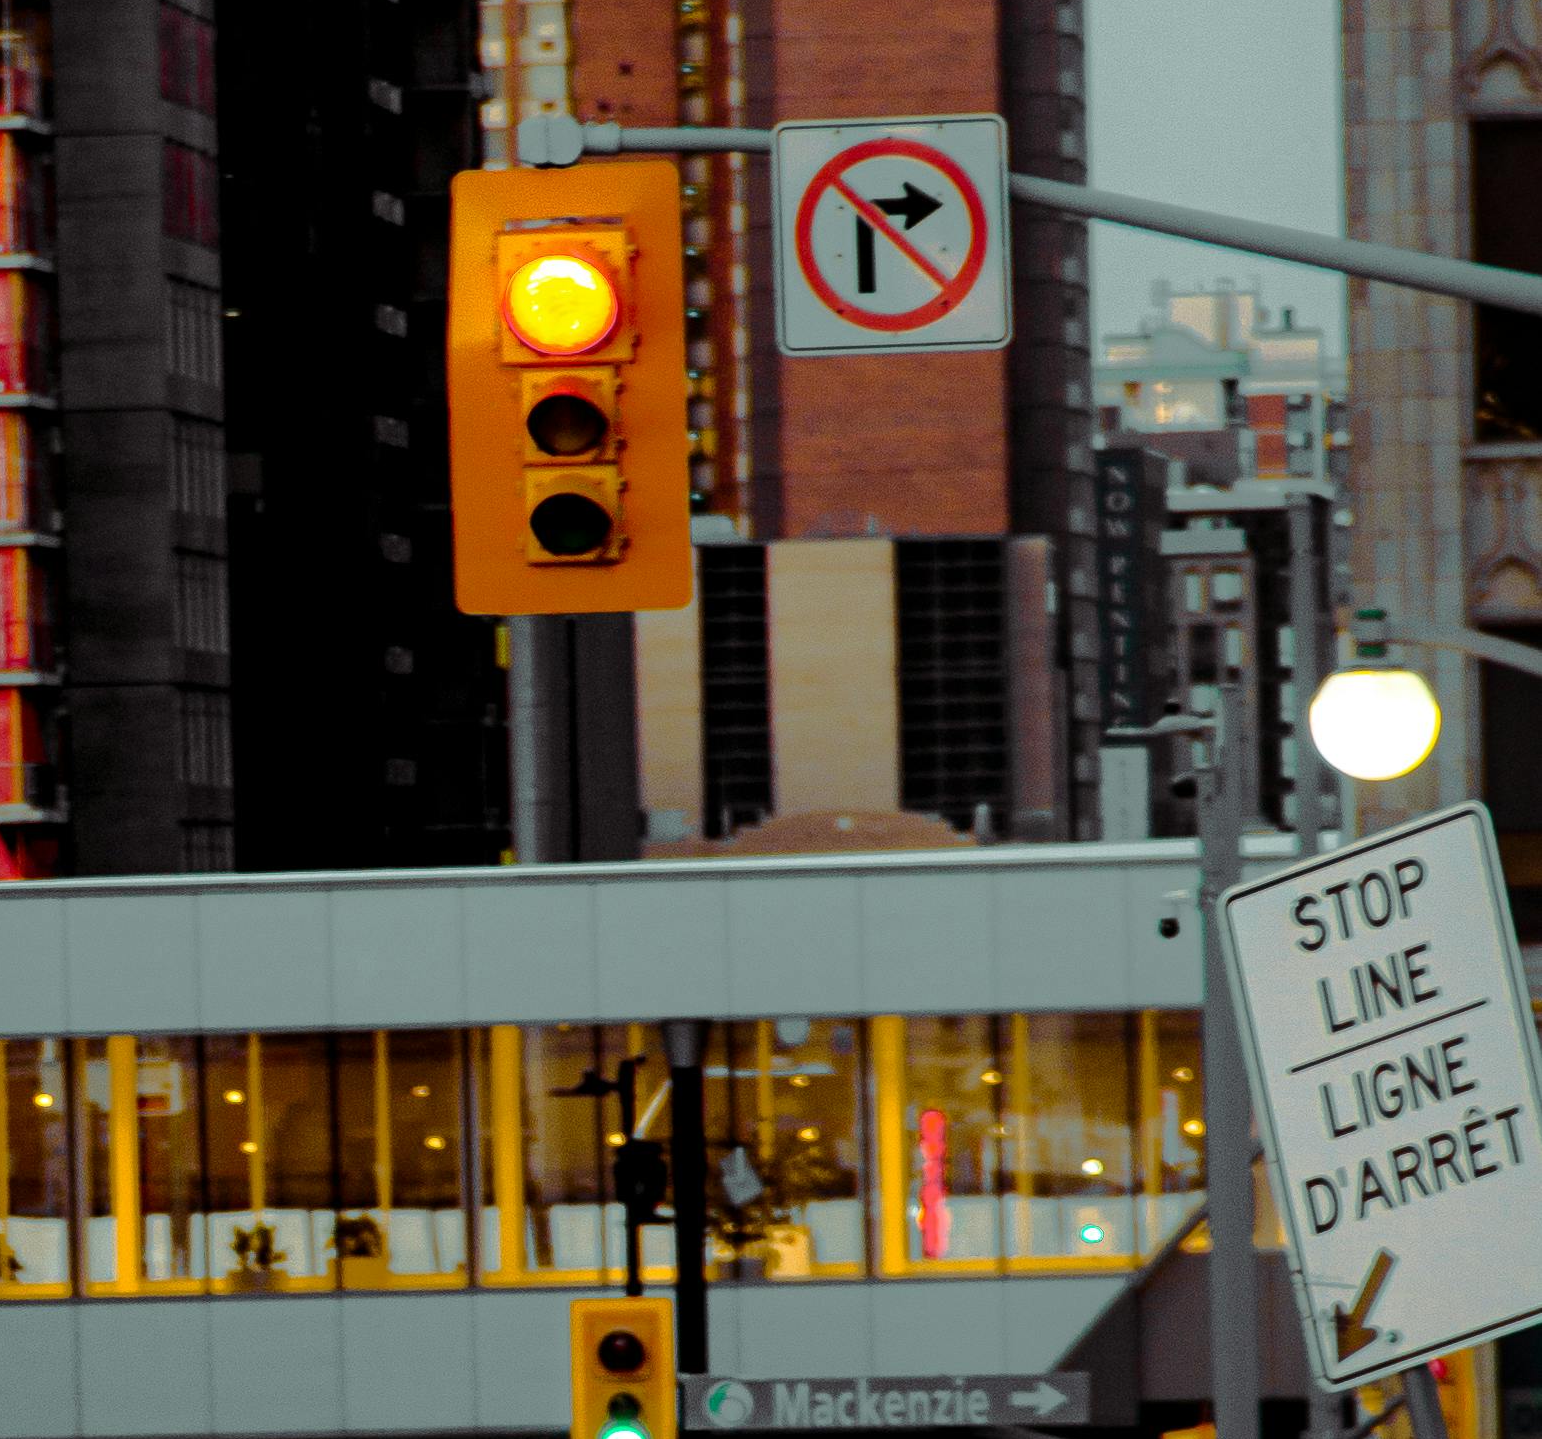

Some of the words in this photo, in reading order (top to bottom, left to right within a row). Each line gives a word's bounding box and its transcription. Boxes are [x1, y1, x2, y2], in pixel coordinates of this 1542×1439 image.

[1294, 859, 1425, 952] STOP
[1317, 942, 1439, 1035] LINE
[1321, 1035, 1477, 1139] LIGNE
[1305, 1108, 1523, 1233] D'ARRÊT
[772, 1378, 991, 1427] Mackenzie
